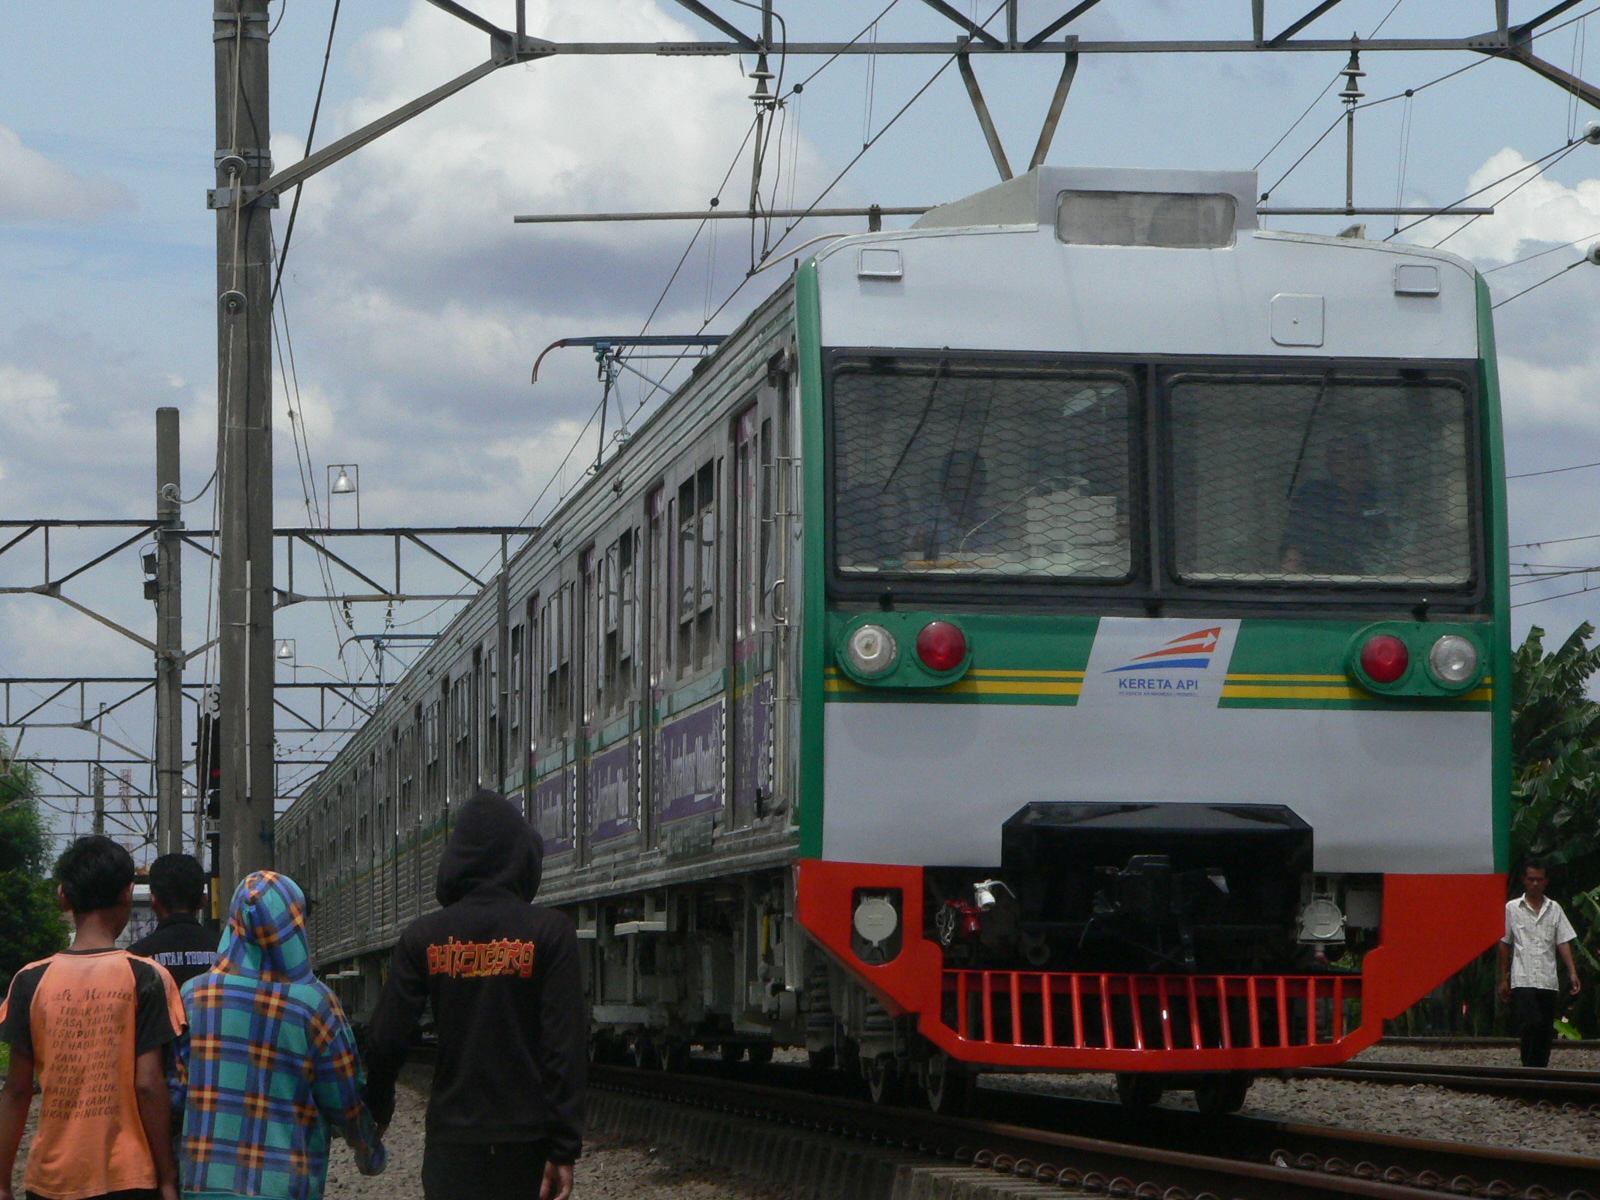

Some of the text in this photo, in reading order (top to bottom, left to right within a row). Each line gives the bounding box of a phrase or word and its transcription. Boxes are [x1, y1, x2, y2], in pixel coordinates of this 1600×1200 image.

[1119, 678, 1198, 690] KERETA API
[150, 951, 184, 966] AUTAN
